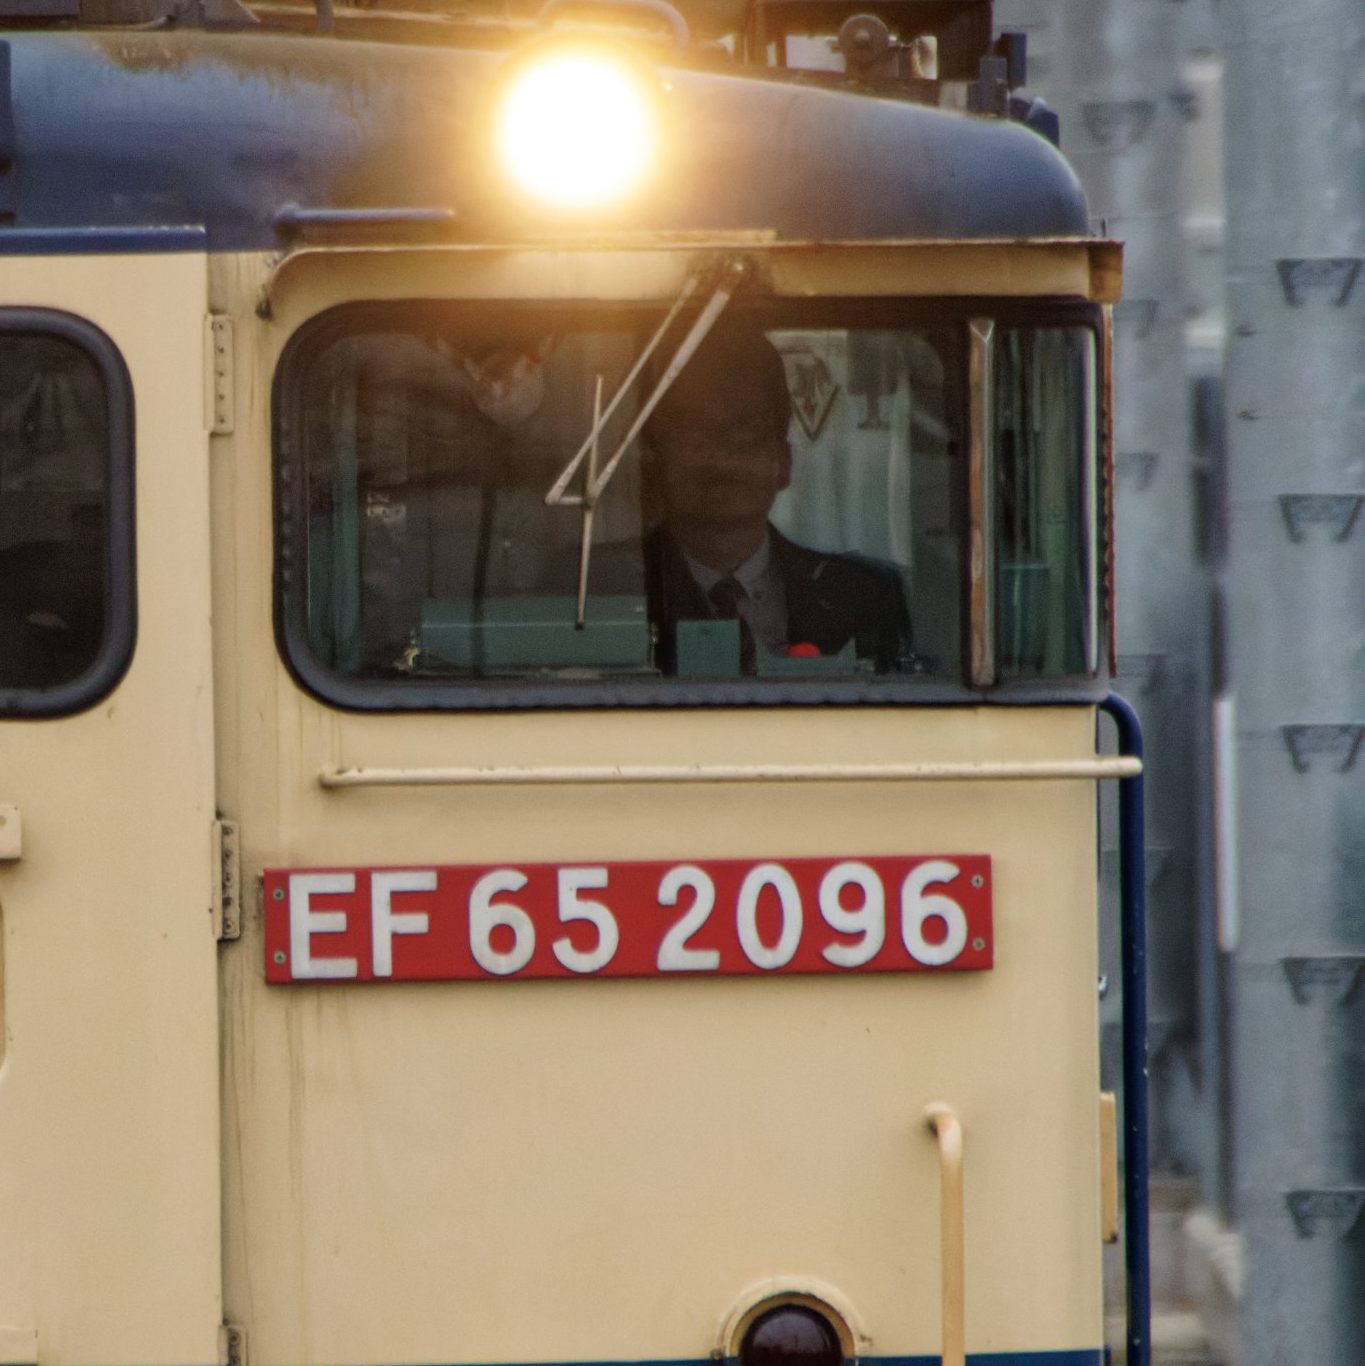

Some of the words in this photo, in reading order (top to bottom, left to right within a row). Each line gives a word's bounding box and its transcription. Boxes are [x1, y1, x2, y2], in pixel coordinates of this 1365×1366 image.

[288, 871, 439, 979] EF
[468, 867, 620, 975] 65
[655, 860, 969, 972] 2096
